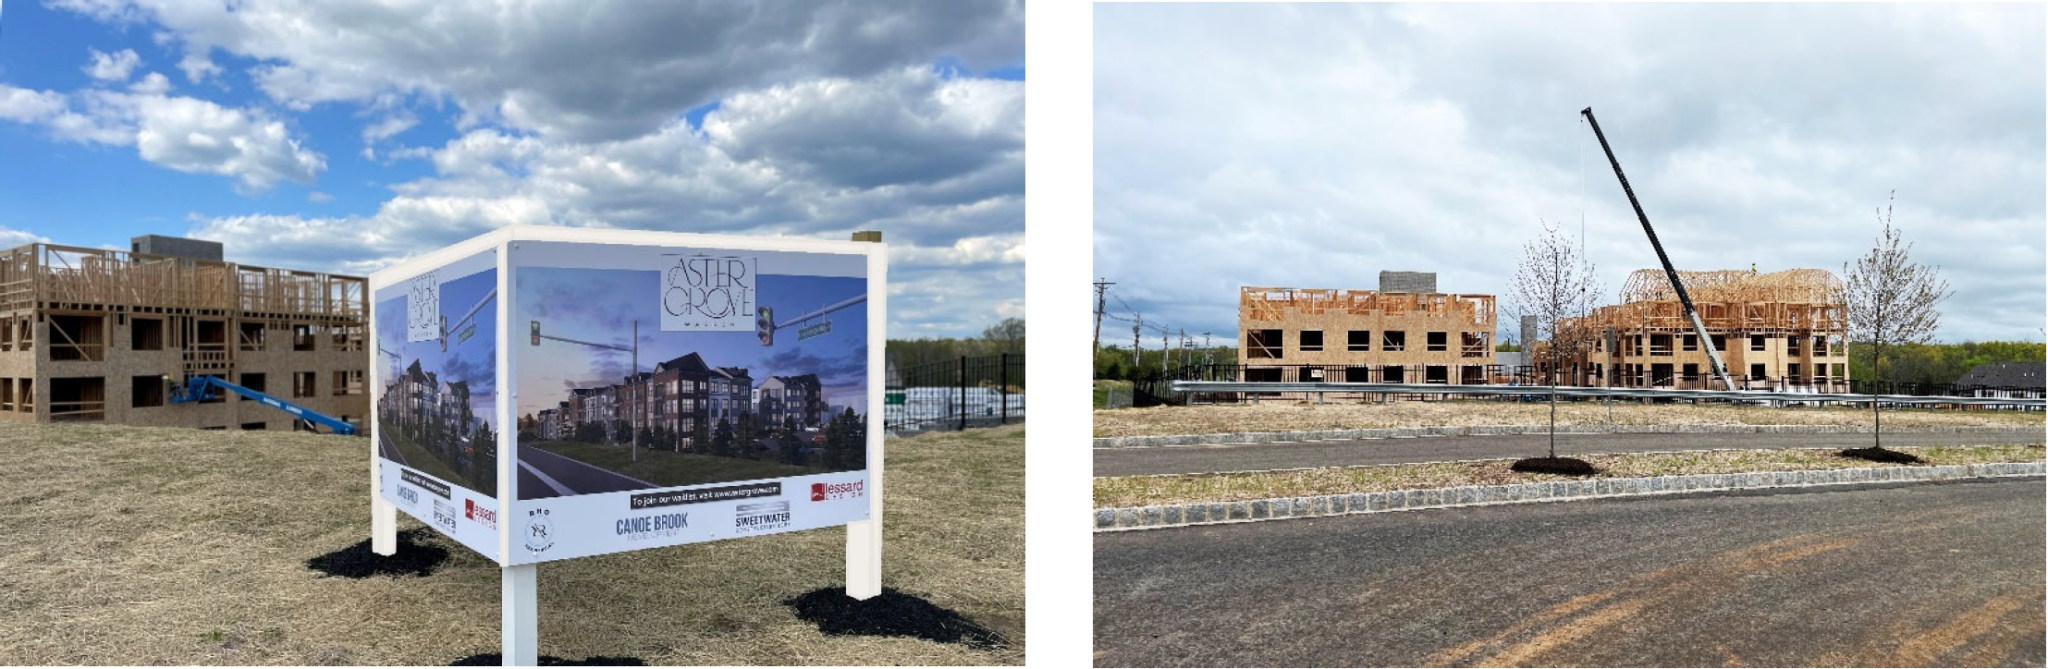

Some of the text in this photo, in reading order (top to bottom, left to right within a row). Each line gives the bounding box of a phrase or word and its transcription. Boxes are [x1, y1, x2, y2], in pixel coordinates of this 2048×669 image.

[667, 258, 748, 288] ASTER
[664, 286, 754, 319] GROVE
[825, 479, 864, 495] lessard
[632, 497, 643, 506] To
[643, 495, 657, 507] join
[658, 496, 671, 504] our
[616, 512, 688, 536] CANOE BROOK
[736, 511, 790, 527] SWEETWATER
